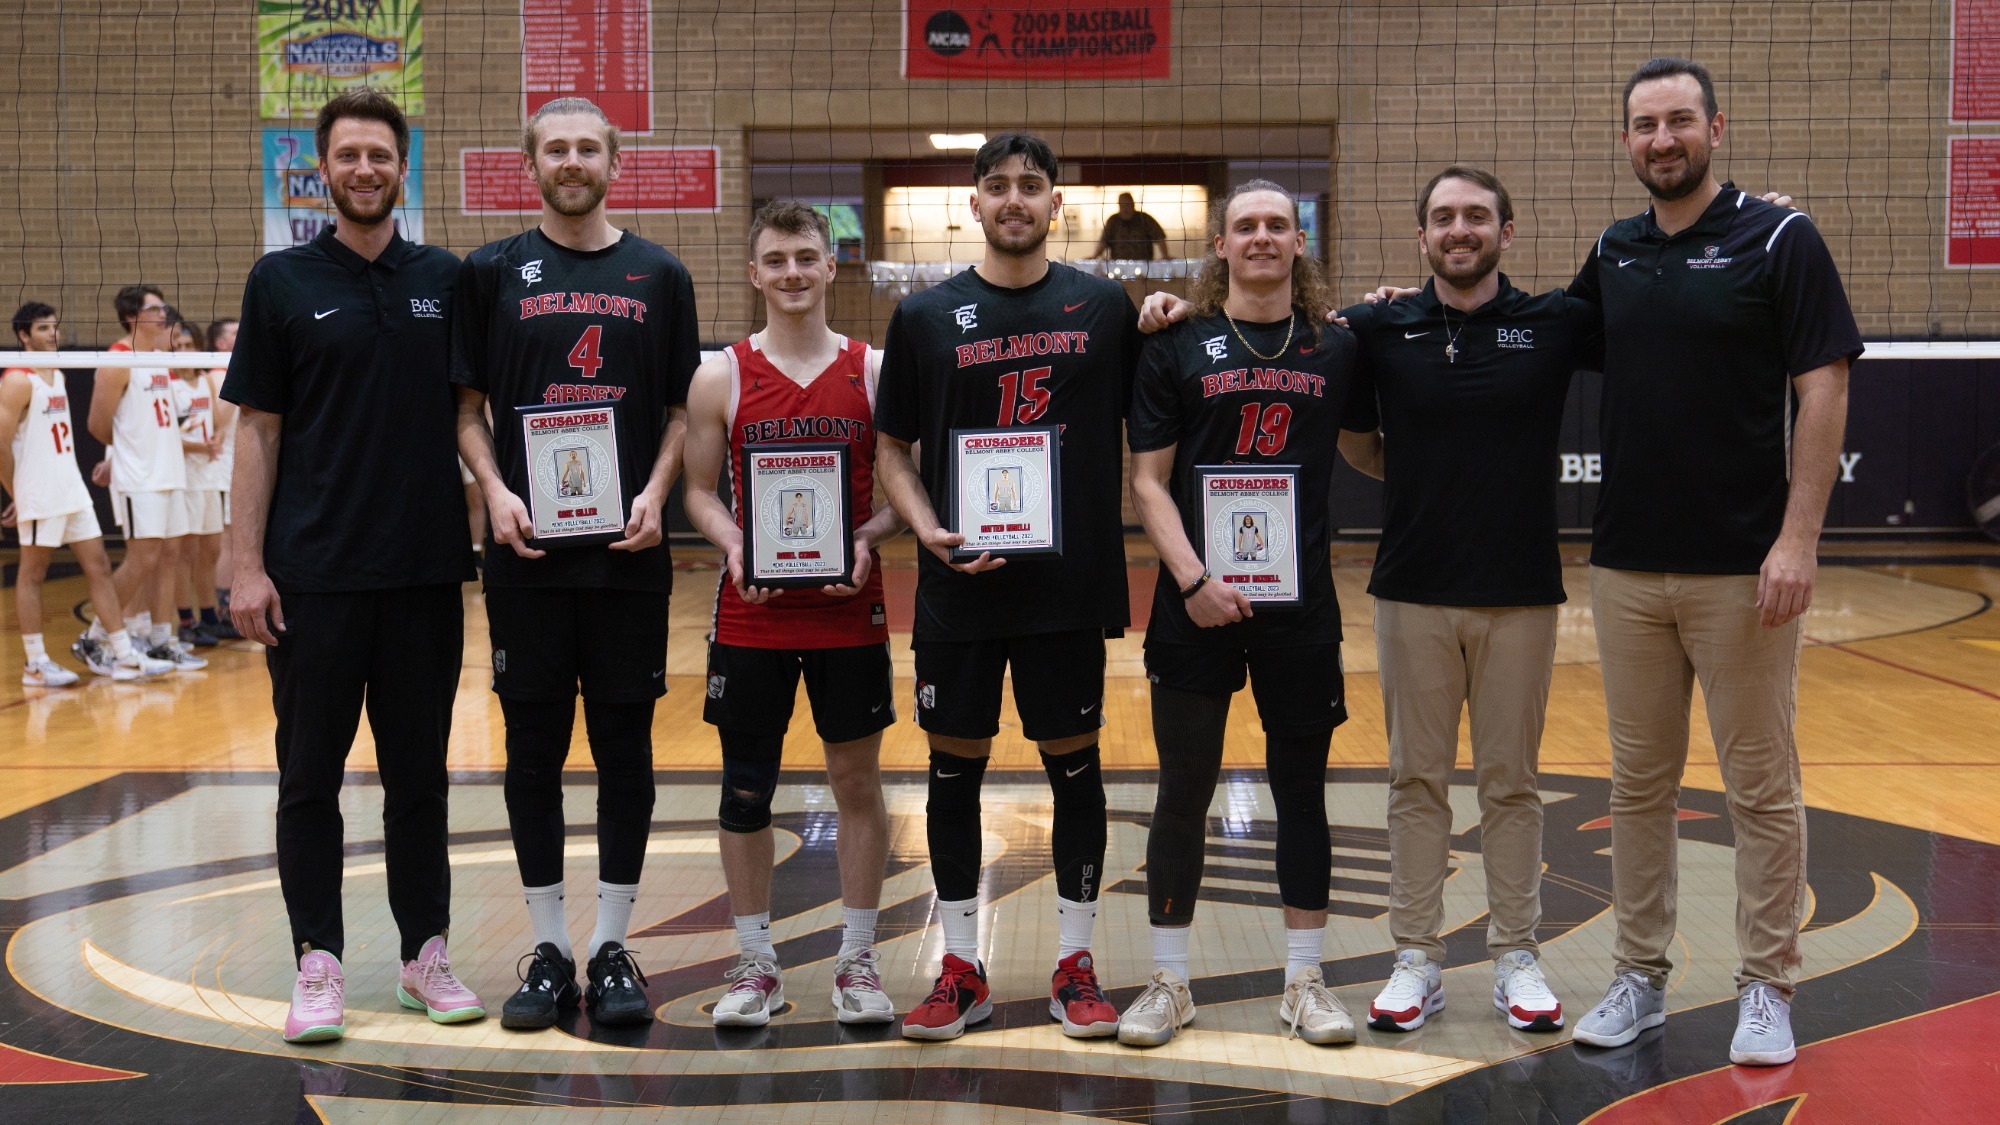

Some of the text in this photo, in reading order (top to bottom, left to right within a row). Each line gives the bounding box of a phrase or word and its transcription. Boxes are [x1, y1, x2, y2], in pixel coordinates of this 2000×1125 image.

[302, 0, 380, 21] 2017
[1012, 8, 1152, 34] 2009 BASEBALL
[928, 31, 970, 48] NCAA
[1012, 33, 1156, 58] CHAMPIONSHIP
[286, 41, 398, 63] NATIONALS
[410, 298, 441, 312] BAC
[520, 292, 647, 324] BELMONT
[1496, 328, 1534, 342] BAC
[568, 325, 604, 378] 4
[956, 332, 1089, 368] BELMONT
[543, 383, 626, 404] ABBEY
[1202, 368, 1326, 398] BELMONT
[997, 366, 1052, 426] 15
[530, 413, 608, 428] CRUSADERS
[742, 416, 866, 444] BELMONT
[1234, 402, 1292, 456] 19
[965, 436, 1044, 448] CRUSADERS
[758, 456, 835, 468] CRUSADERS
[1210, 479, 1288, 489] CRUSADERS
